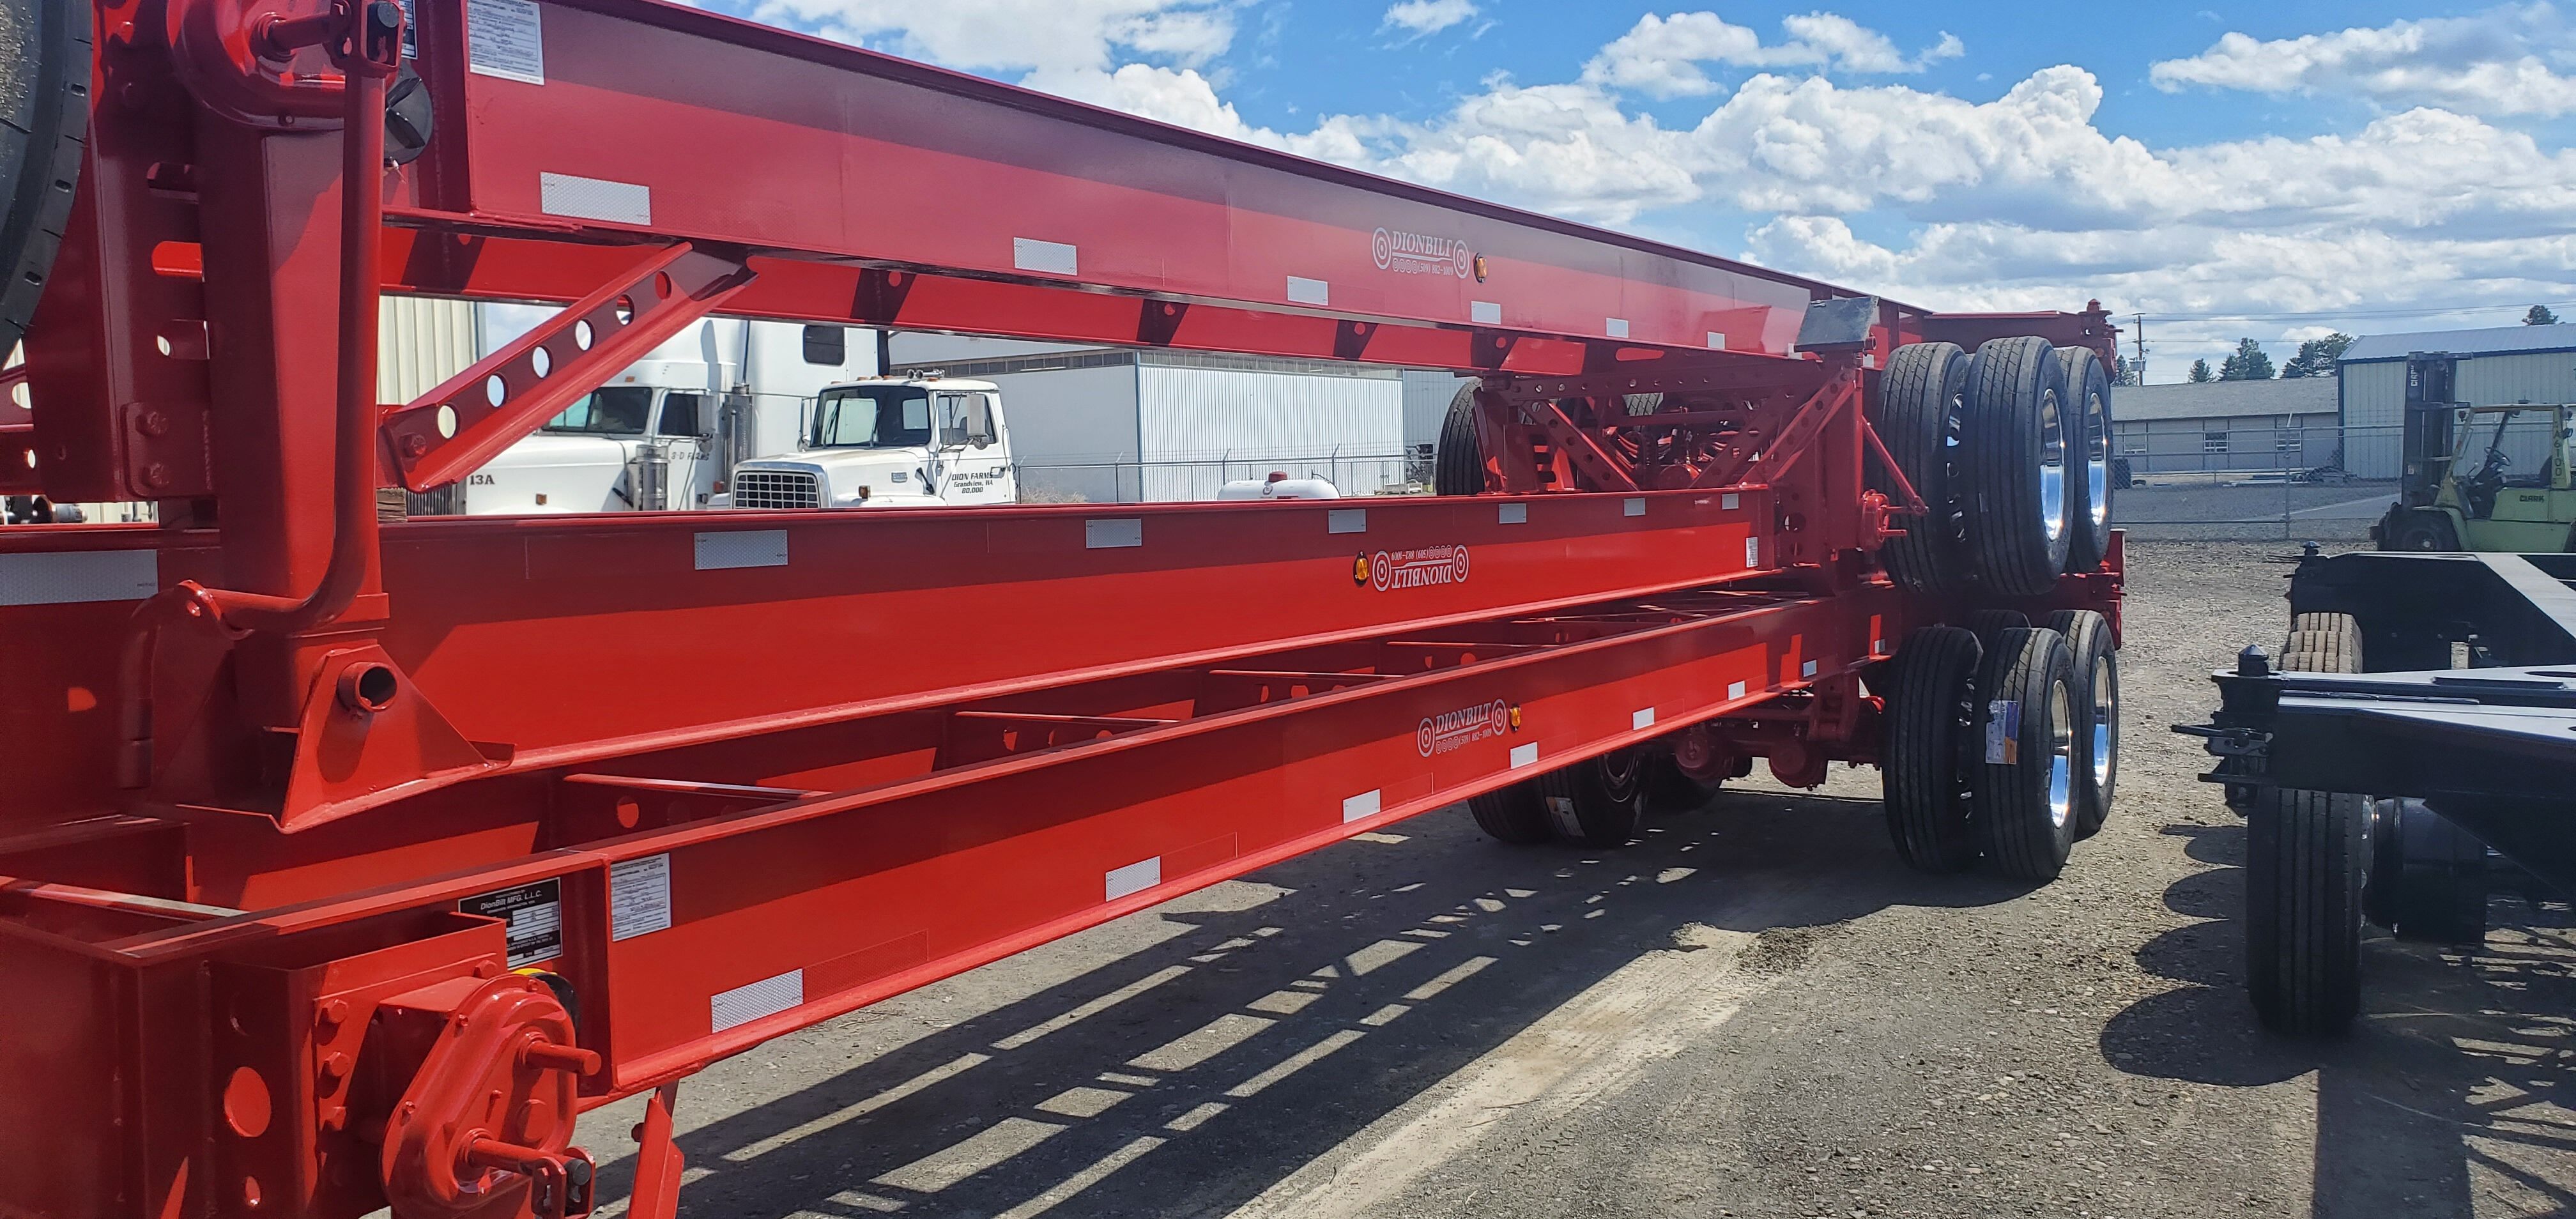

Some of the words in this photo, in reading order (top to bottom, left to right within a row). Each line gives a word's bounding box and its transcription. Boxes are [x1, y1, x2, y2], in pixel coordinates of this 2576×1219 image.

[1392, 231, 1452, 257] DIONBILT
[1418, 262, 1430, 274] (509)
[470, 475, 495, 485] 13A
[970, 472, 993, 480] FARMS
[1391, 550, 1414, 561] 882-1009
[1416, 548, 1428, 559] (509)
[1392, 565, 1452, 588] DIONBILT
[1436, 702, 1491, 734] DIONBILT
[1459, 733, 1471, 746] (509)
[480, 898, 506, 910] DionBilt
[507, 894, 522, 904] MFG.
